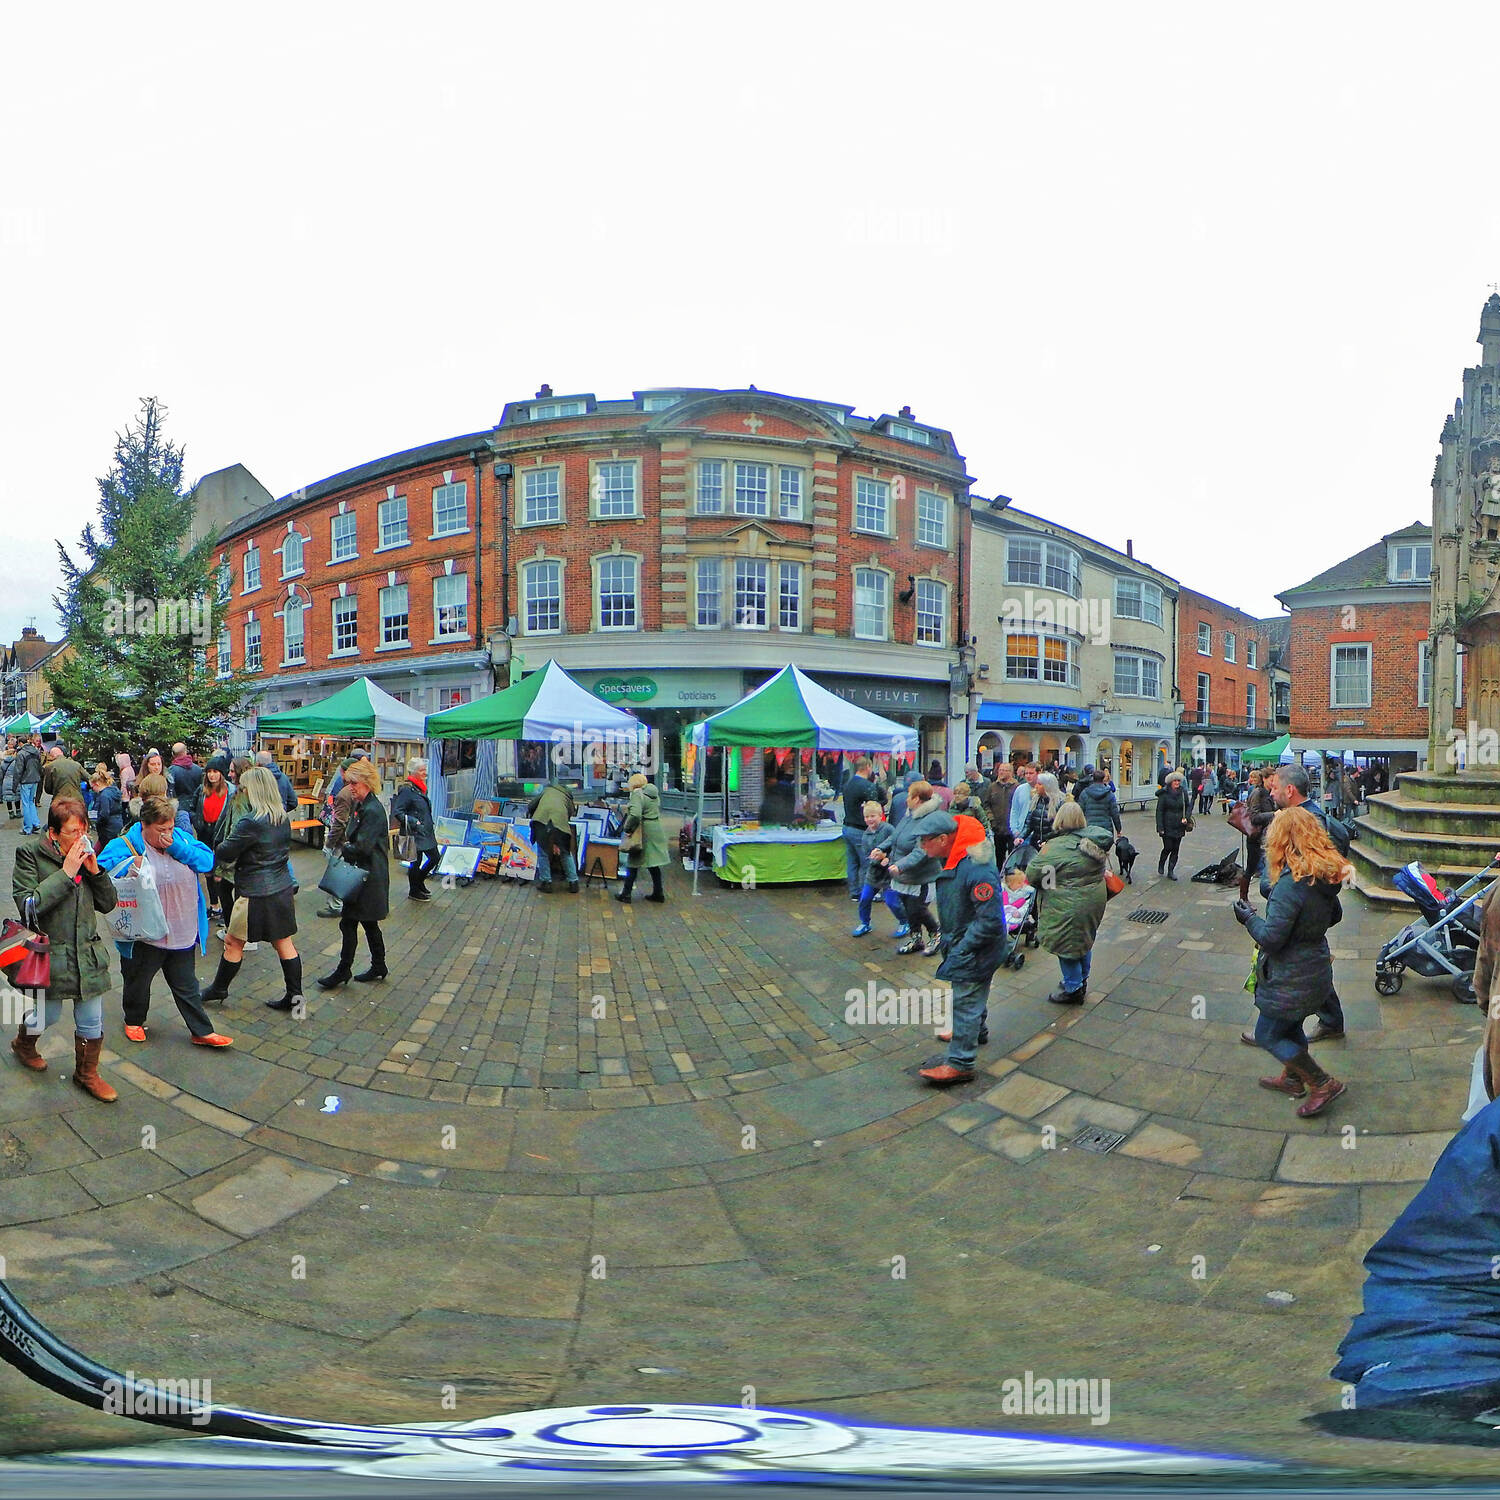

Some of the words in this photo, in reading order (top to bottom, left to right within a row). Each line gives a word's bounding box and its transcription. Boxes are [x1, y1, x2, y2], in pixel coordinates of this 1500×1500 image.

[600, 683, 651, 694] Specsavers
[678, 690, 717, 701] Opticians
[864, 690, 919, 703] VELVET
